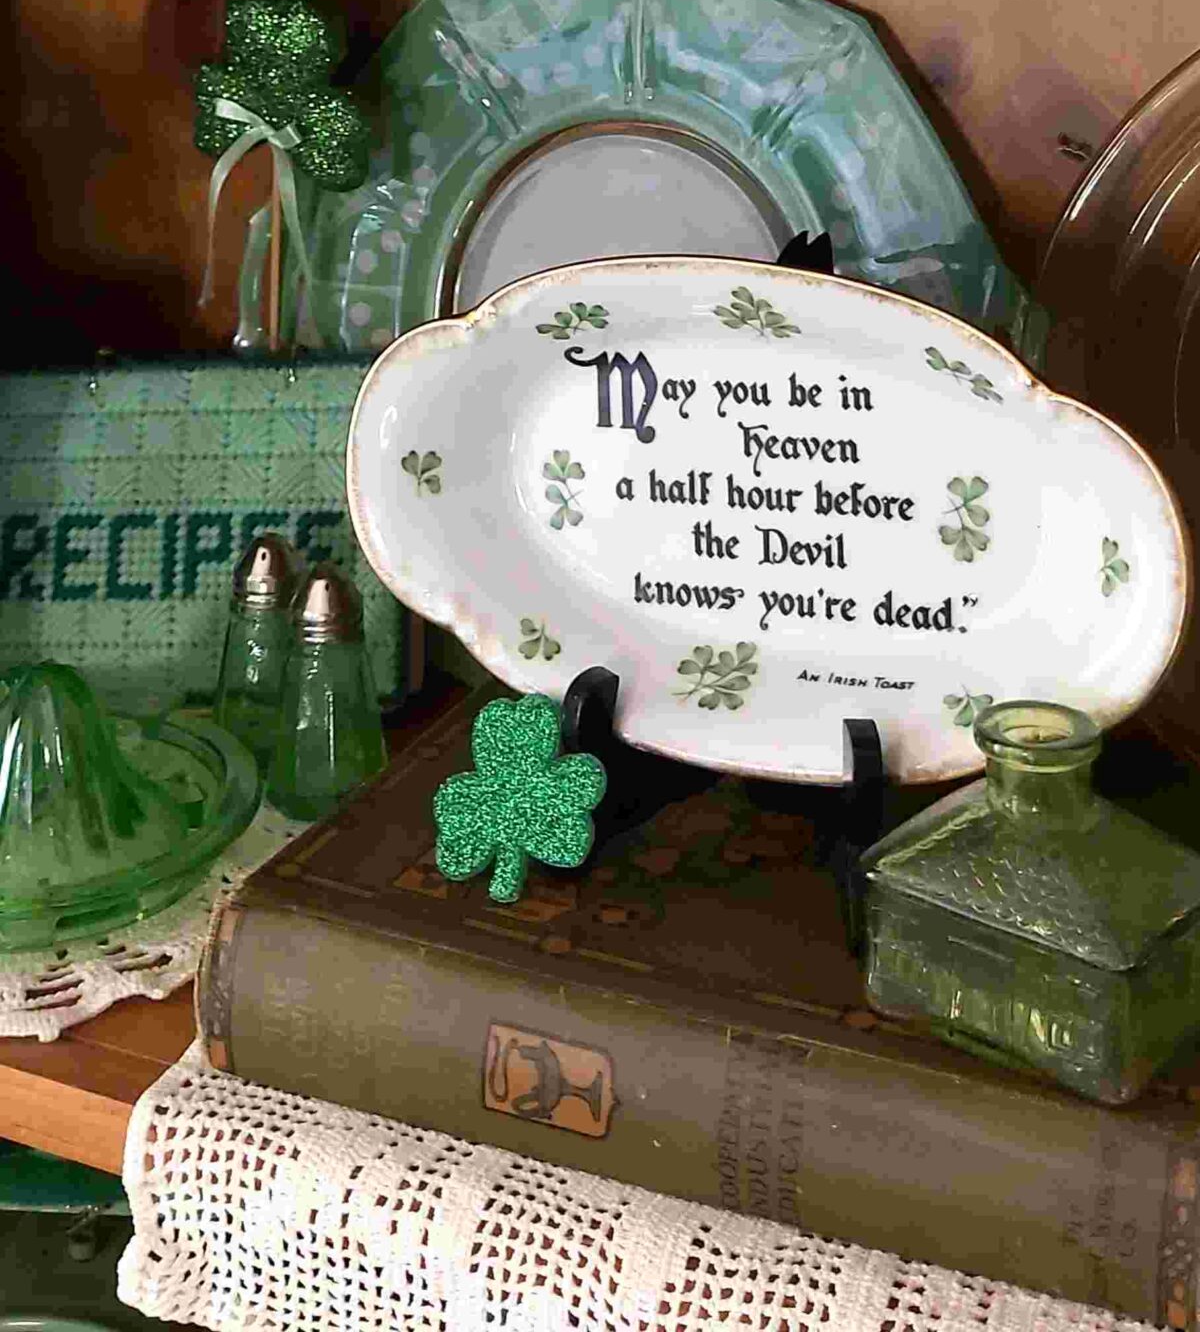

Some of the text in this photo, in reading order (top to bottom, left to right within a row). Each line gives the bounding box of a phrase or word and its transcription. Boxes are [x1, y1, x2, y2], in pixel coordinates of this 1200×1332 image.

[564, 346, 874, 444] May you be in
[615, 469, 915, 521] a half hour before
[691, 520, 848, 569] the Devil
[634, 571, 745, 610] knows
[758, 587, 857, 631] you're
[827, 672, 868, 687] IRISH
[874, 676, 915, 690] TOAST
